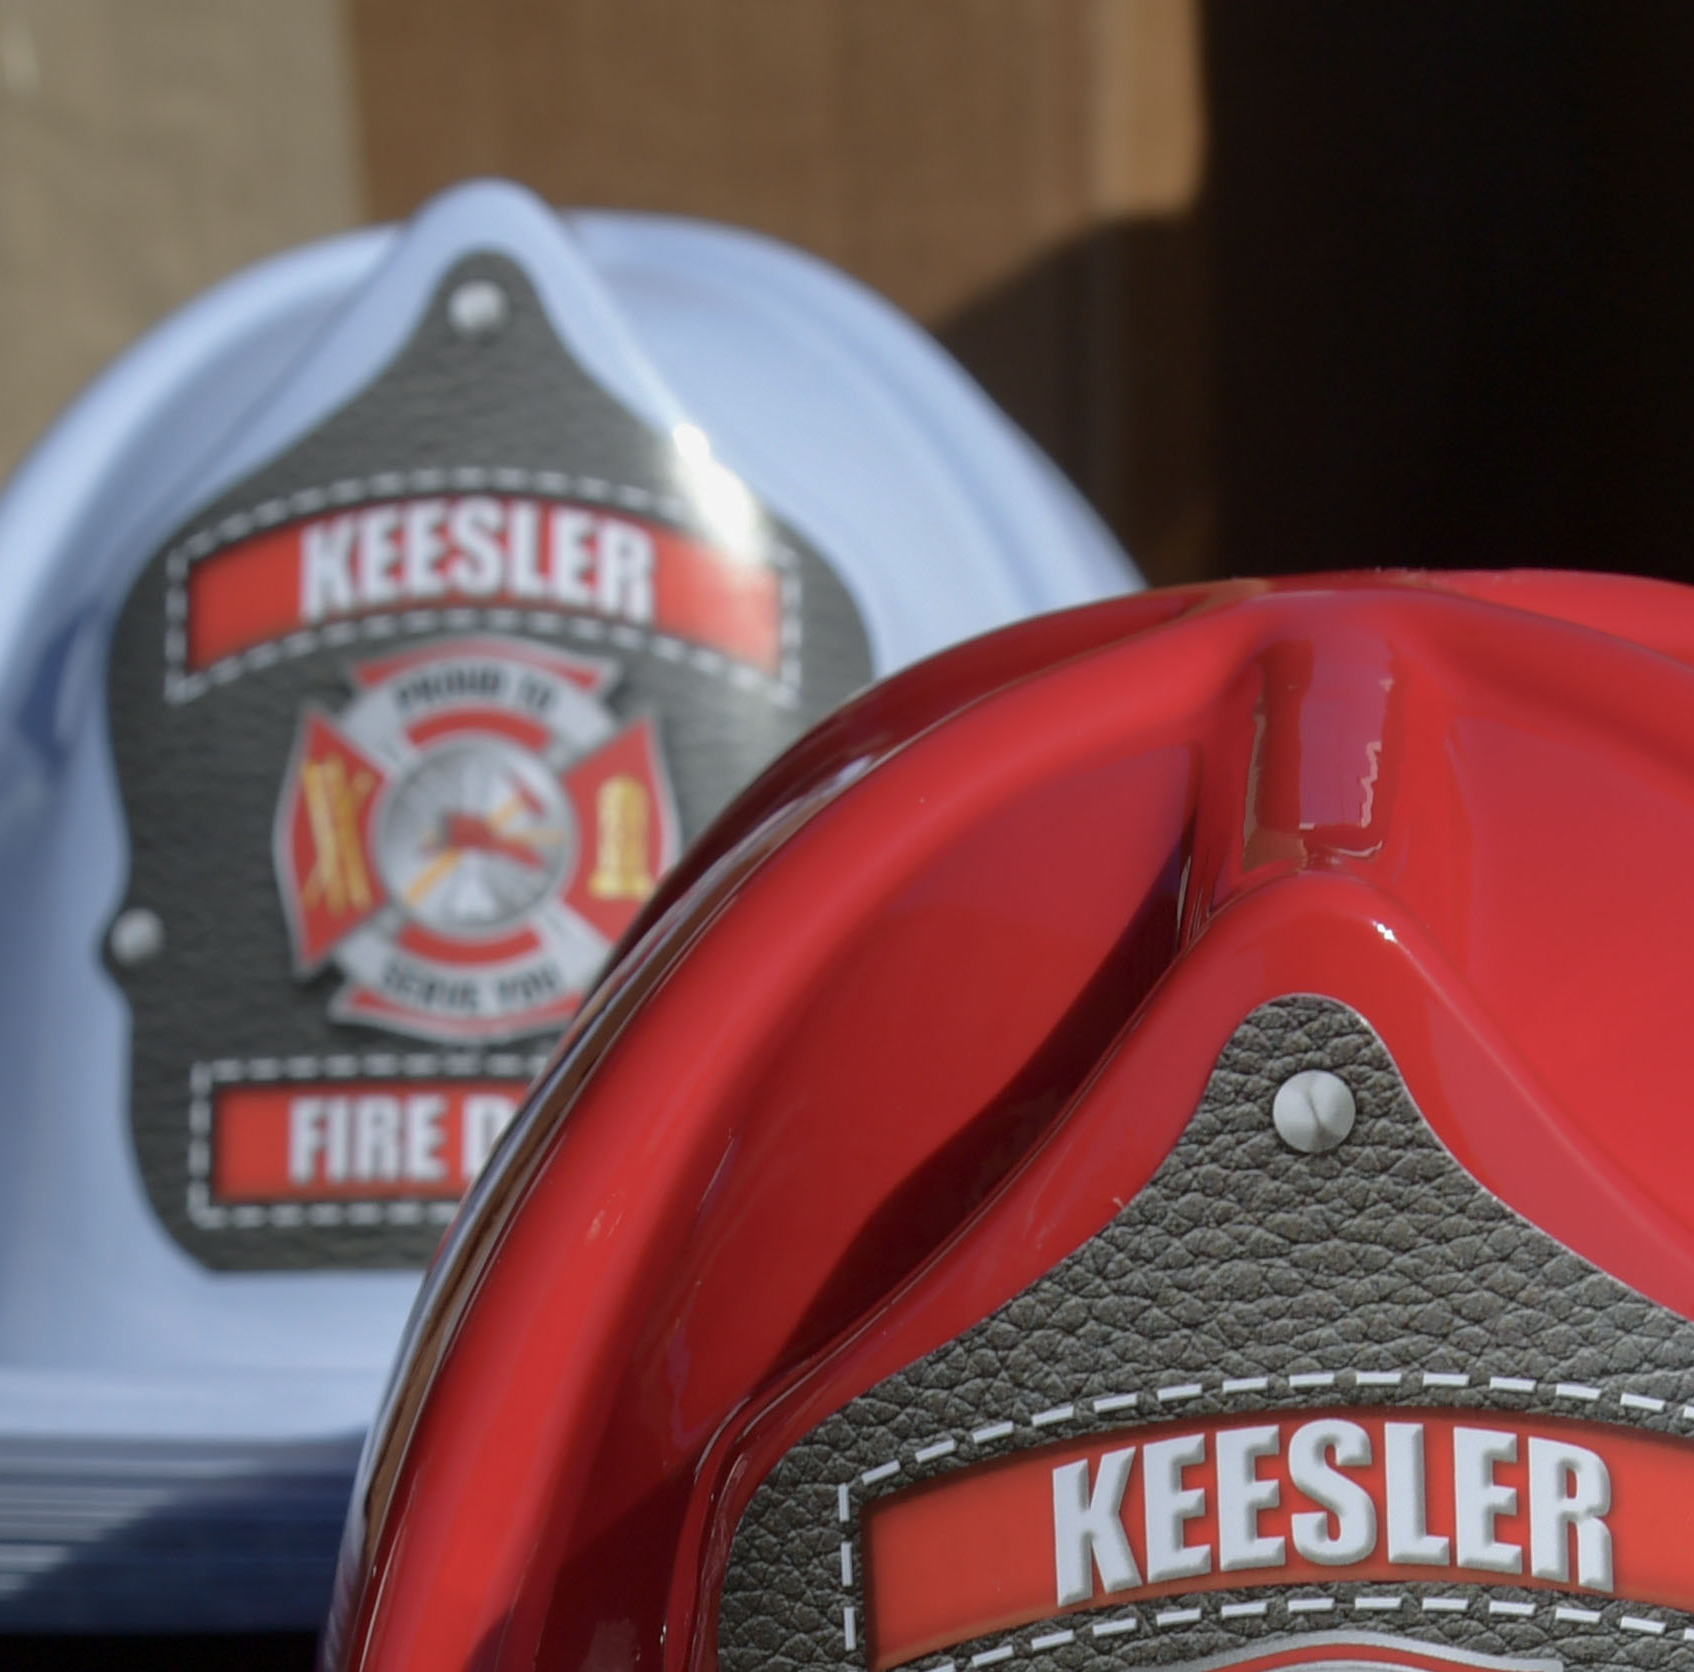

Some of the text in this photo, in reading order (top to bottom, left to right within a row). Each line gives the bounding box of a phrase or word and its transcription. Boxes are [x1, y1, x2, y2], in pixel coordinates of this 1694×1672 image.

[300, 495, 655, 624] KEESLER
[288, 1095, 446, 1184] FIRE
[1052, 1418, 1614, 1608] KEESLER
